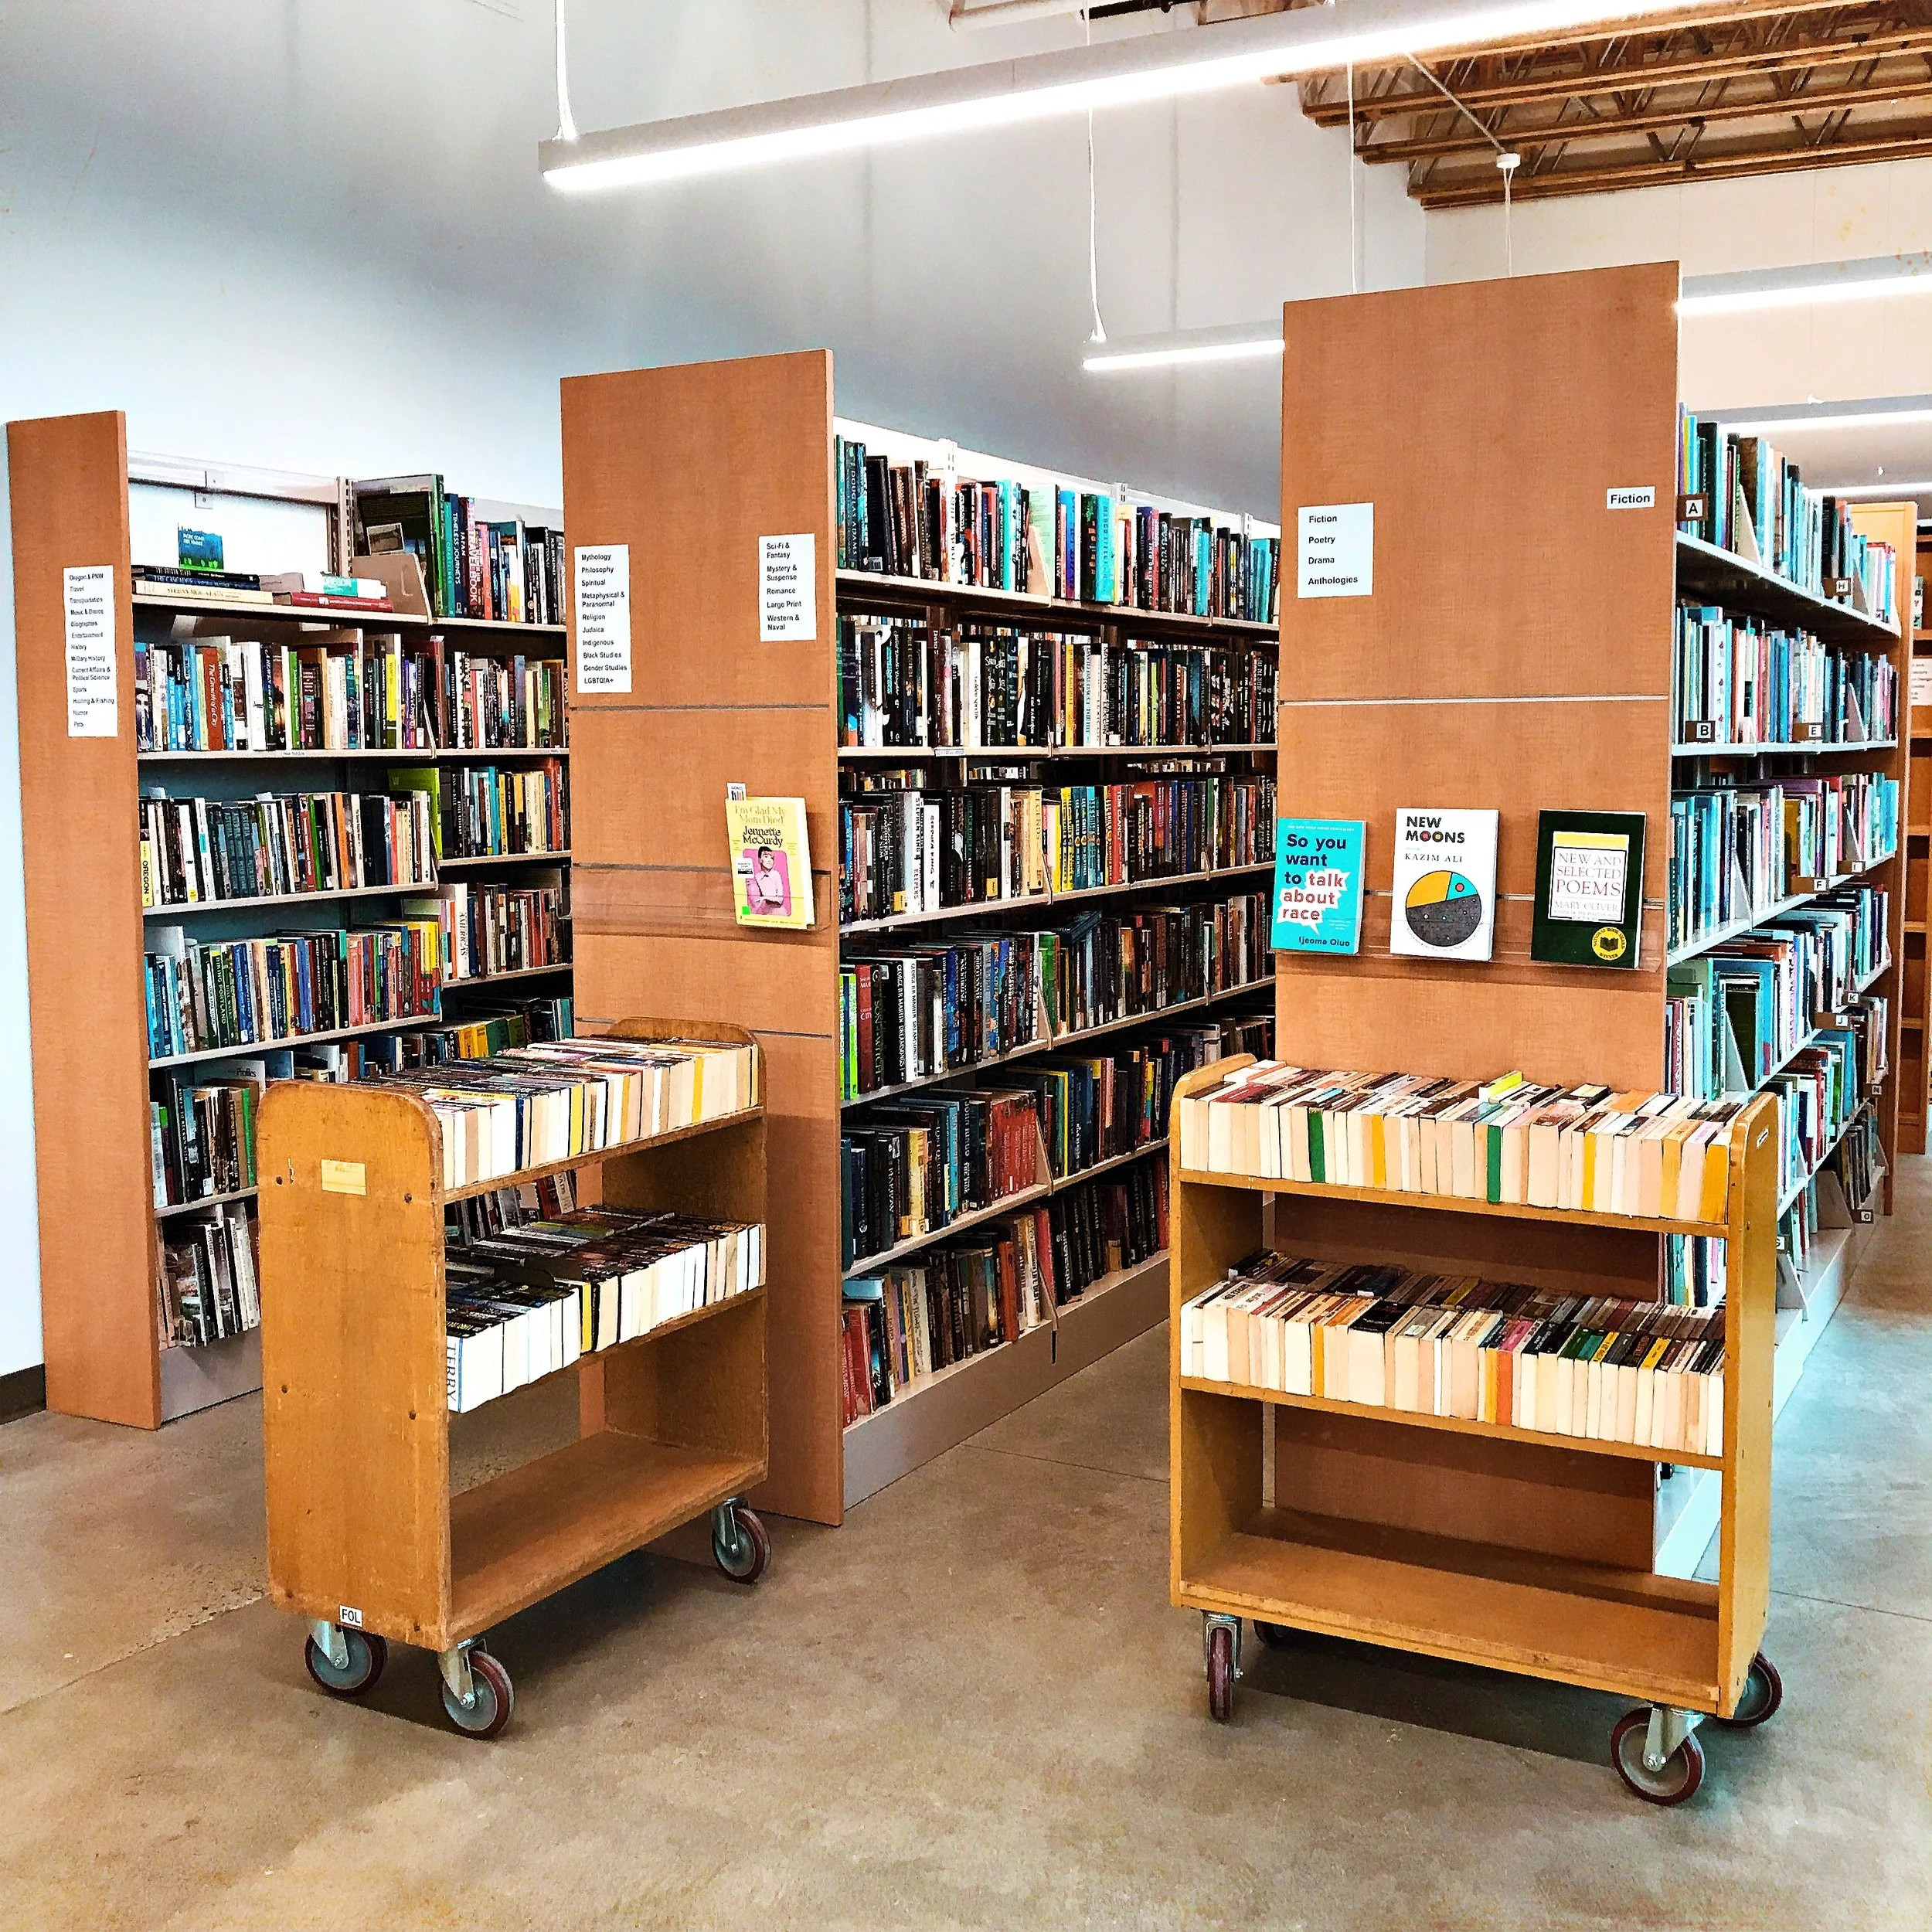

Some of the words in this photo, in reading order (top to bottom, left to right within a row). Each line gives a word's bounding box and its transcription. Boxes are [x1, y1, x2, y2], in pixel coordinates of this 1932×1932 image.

[1611, 494, 1651, 504] Fiction
[1689, 502, 1699, 514] A
[1308, 515, 1338, 523] Fiction
[581, 553, 611, 562] Mythology
[767, 565, 791, 573] Mystery
[1308, 577, 1358, 586] Anthologies
[582, 591, 619, 600] Metaphysical
[583, 639, 614, 648] Indigenous
[1700, 725, 1708, 736] B
[1811, 726, 1816, 735] E
[750, 805, 770, 816] Glad
[772, 806, 786, 818] My
[739, 815, 762, 824] Mom
[761, 815, 784, 825] Died
[1406, 815, 1442, 828] NEW
[743, 825, 781, 837] Jennette
[1405, 830, 1465, 844] MOONS
[743, 835, 784, 849] McCurdy
[1286, 833, 1308, 848] So
[1315, 837, 1347, 852] you
[1286, 853, 1328, 867] want
[1404, 852, 1440, 862] KAZIM
[1559, 852, 1591, 865] NEW
[1594, 855, 1621, 867] AND
[1556, 865, 1622, 879] SELECTED
[1284, 871, 1302, 885] to
[1309, 873, 1344, 888] talk
[1556, 879, 1621, 896] POEMS
[1284, 889, 1335, 905] about
[1554, 900, 1581, 910] MARY
[1583, 903, 1618, 913] OLIVER
[1282, 907, 1320, 920] race
[1298, 936, 1328, 945] Ijeoma
[1329, 938, 1350, 947] Oluo
[896, 964, 904, 988] GEORGE
[218, 984, 226, 1025] PORTLAND
[897, 1025, 906, 1067] DREAMSONGS
[342, 1608, 361, 1624] FOL
